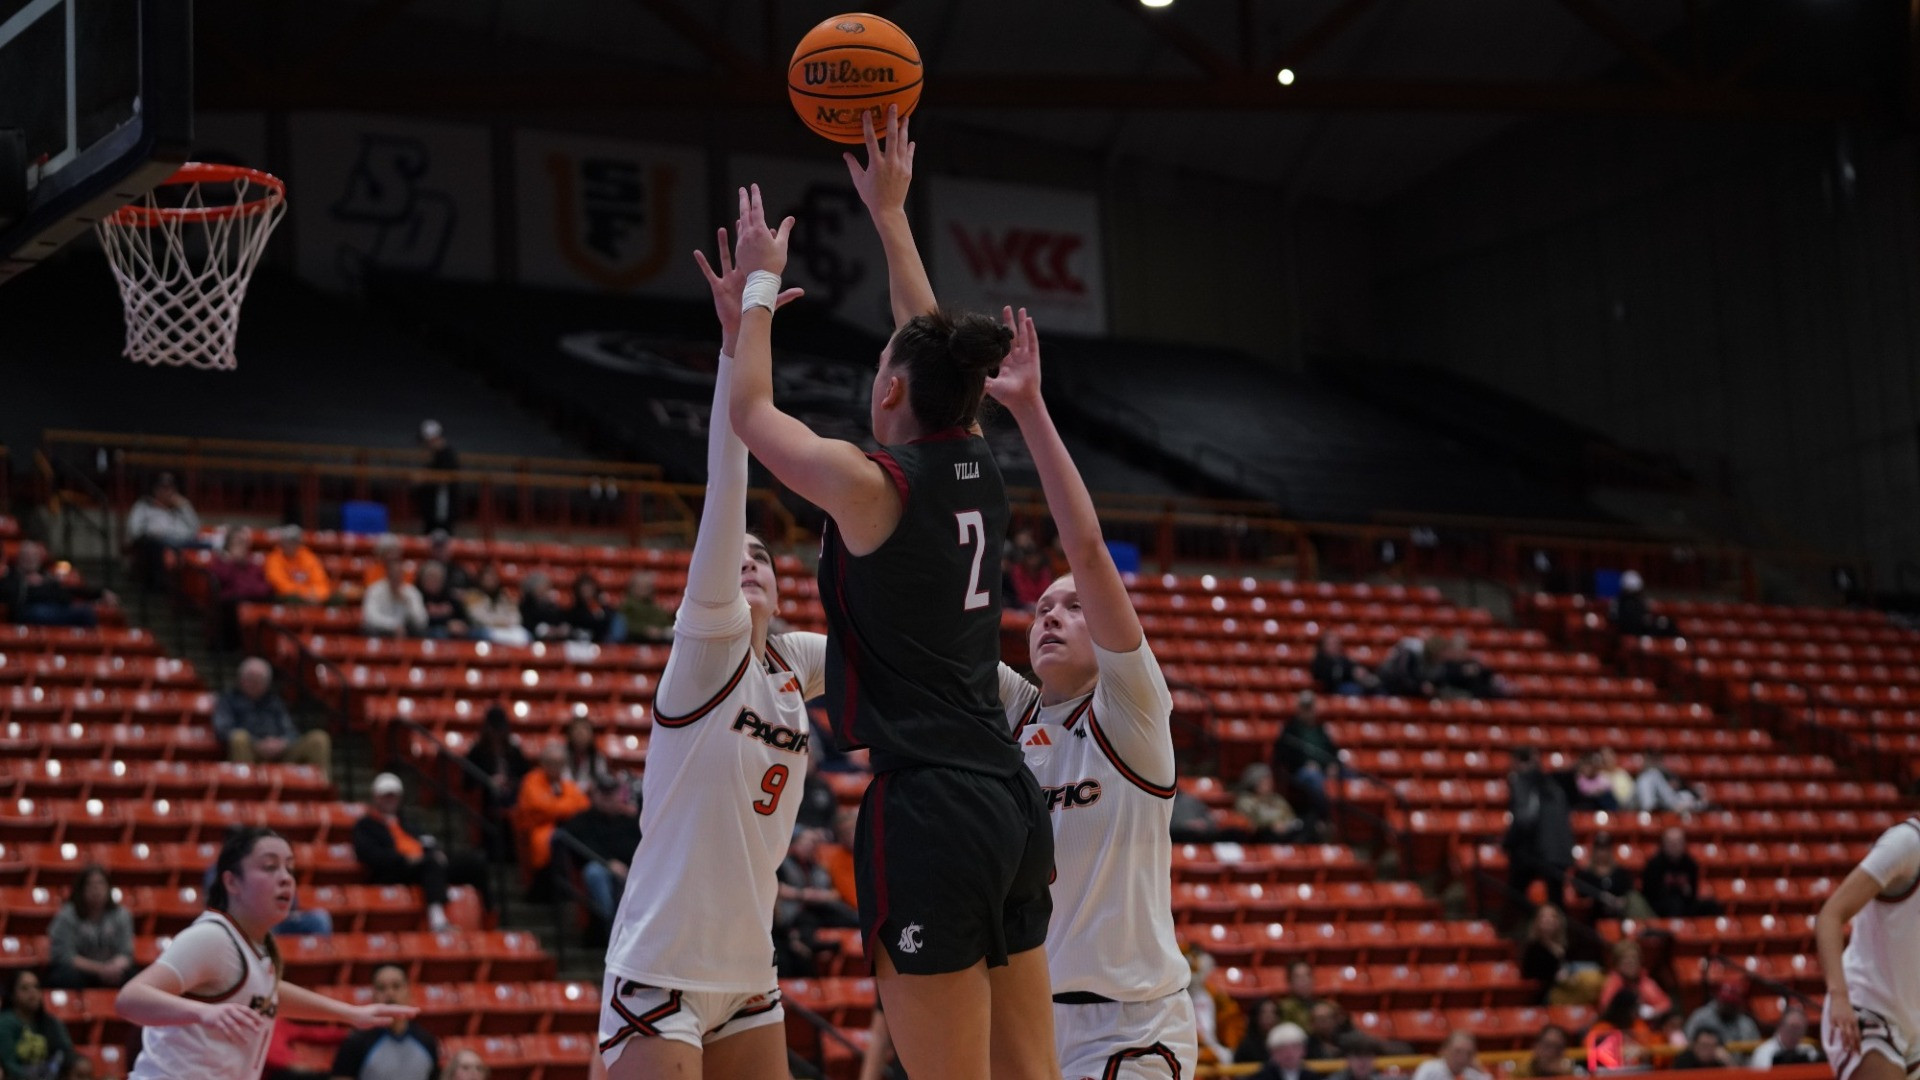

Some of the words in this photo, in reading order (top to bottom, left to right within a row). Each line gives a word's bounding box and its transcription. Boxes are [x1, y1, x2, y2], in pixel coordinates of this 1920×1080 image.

[804, 59, 896, 86] Wilson
[949, 219, 1087, 296] WCC
[954, 461, 980, 481] VILLA
[953, 507, 991, 612] 2
[731, 705, 809, 753] PACIF
[753, 763, 789, 816] 9
